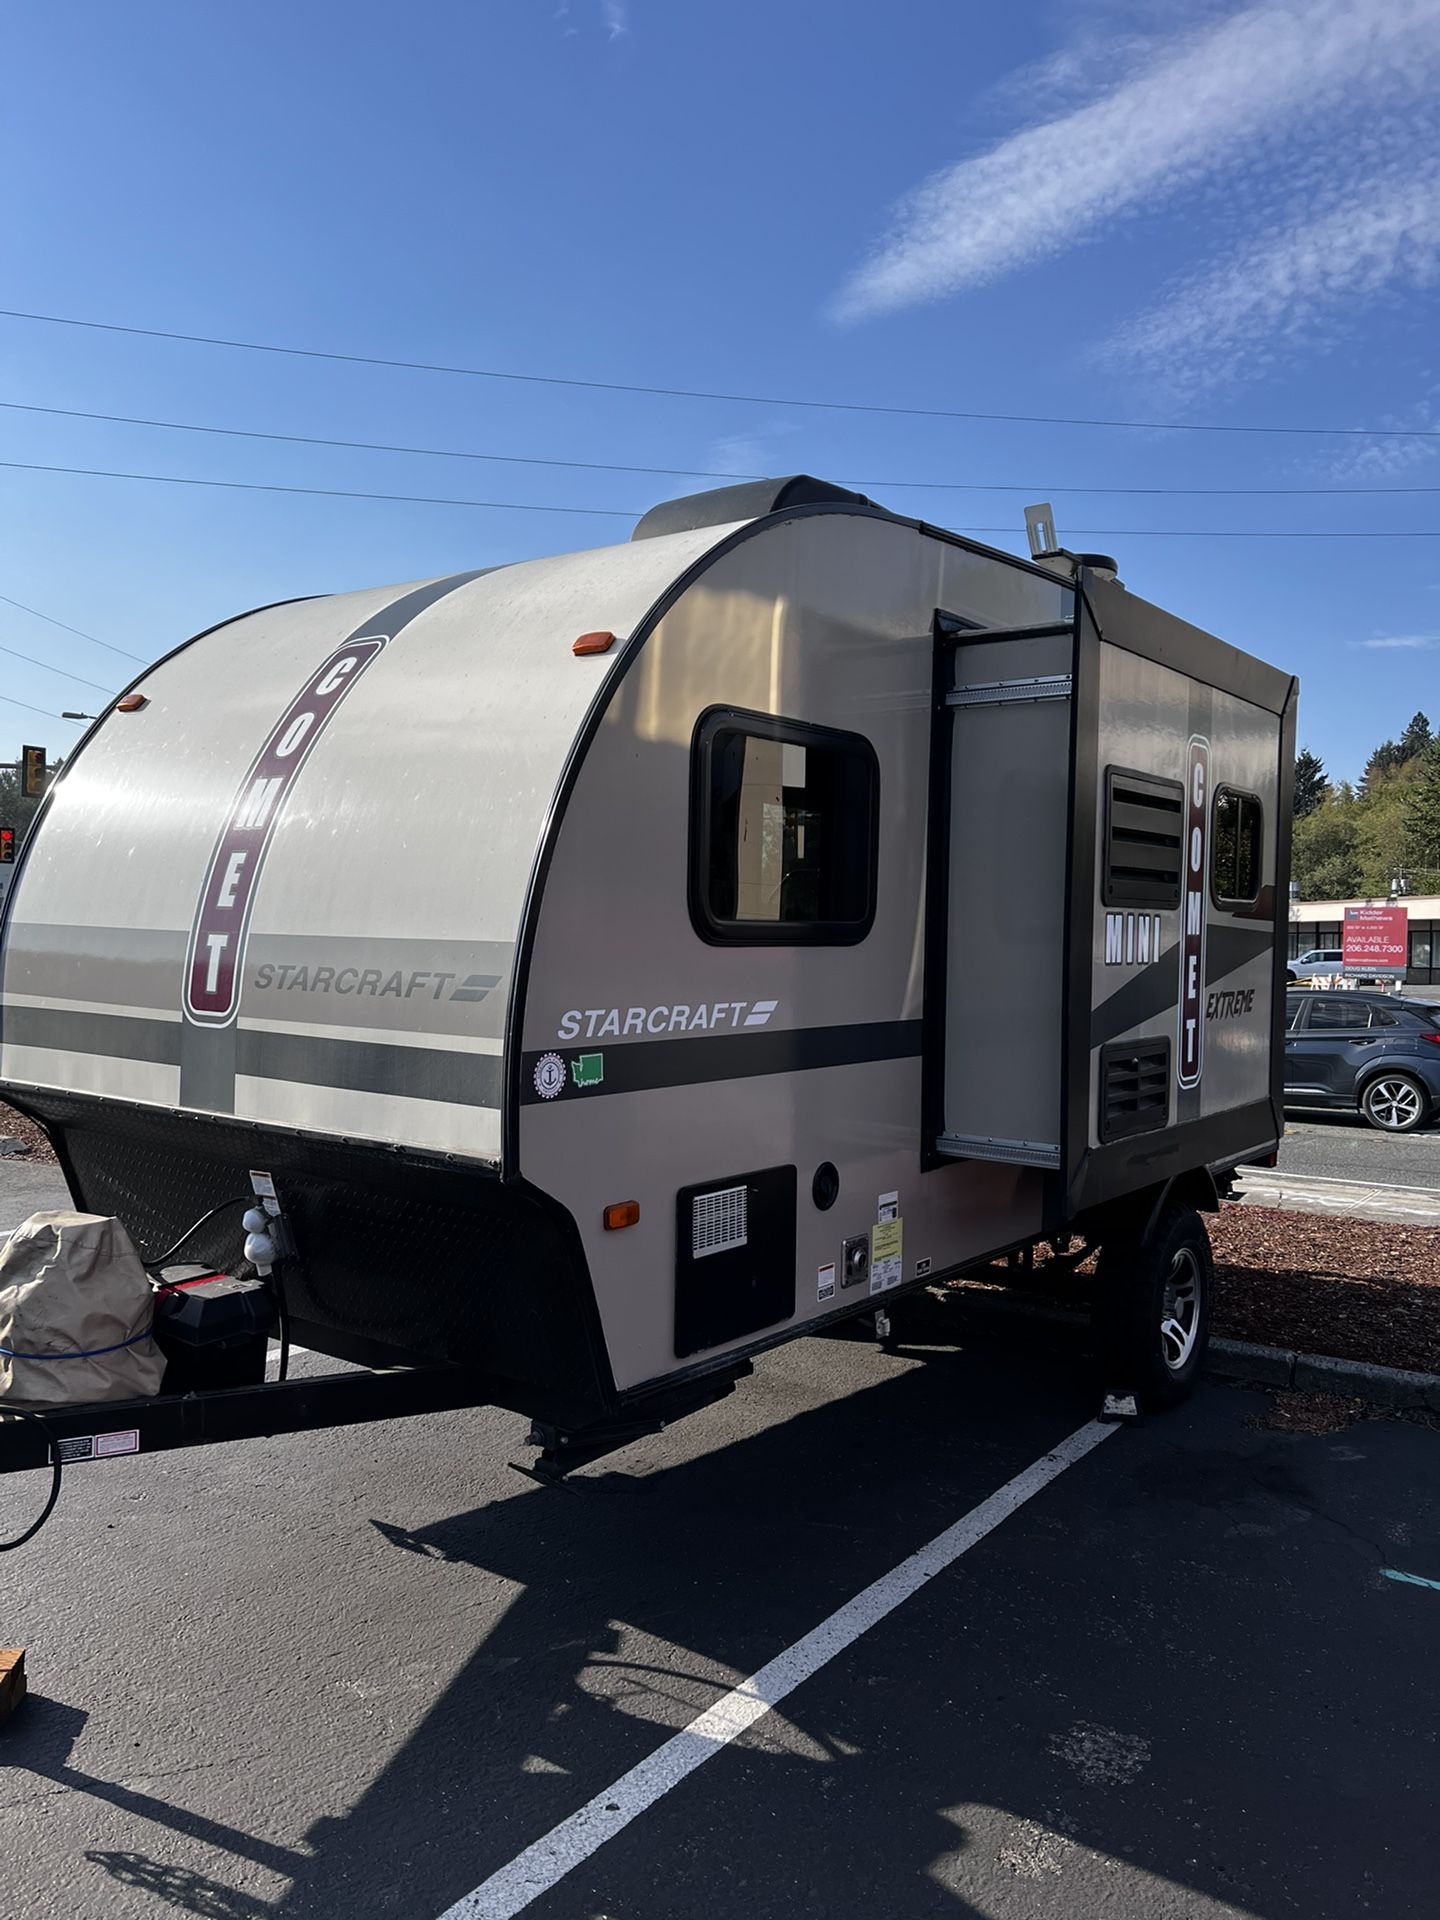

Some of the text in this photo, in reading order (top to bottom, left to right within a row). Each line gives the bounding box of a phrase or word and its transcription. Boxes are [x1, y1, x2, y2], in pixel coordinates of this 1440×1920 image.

[205, 656, 358, 995] COMET
[1186, 762, 1204, 1063] COMET
[1105, 913, 1161, 965] MINI
[1346, 936, 1389, 944] AVAILABLE
[1346, 945, 1403, 953] 206.248.7300
[254, 963, 456, 1002] STARCRAFT
[557, 1001, 747, 1040] STARCRAFT
[1206, 989, 1255, 1021] EXTREME
